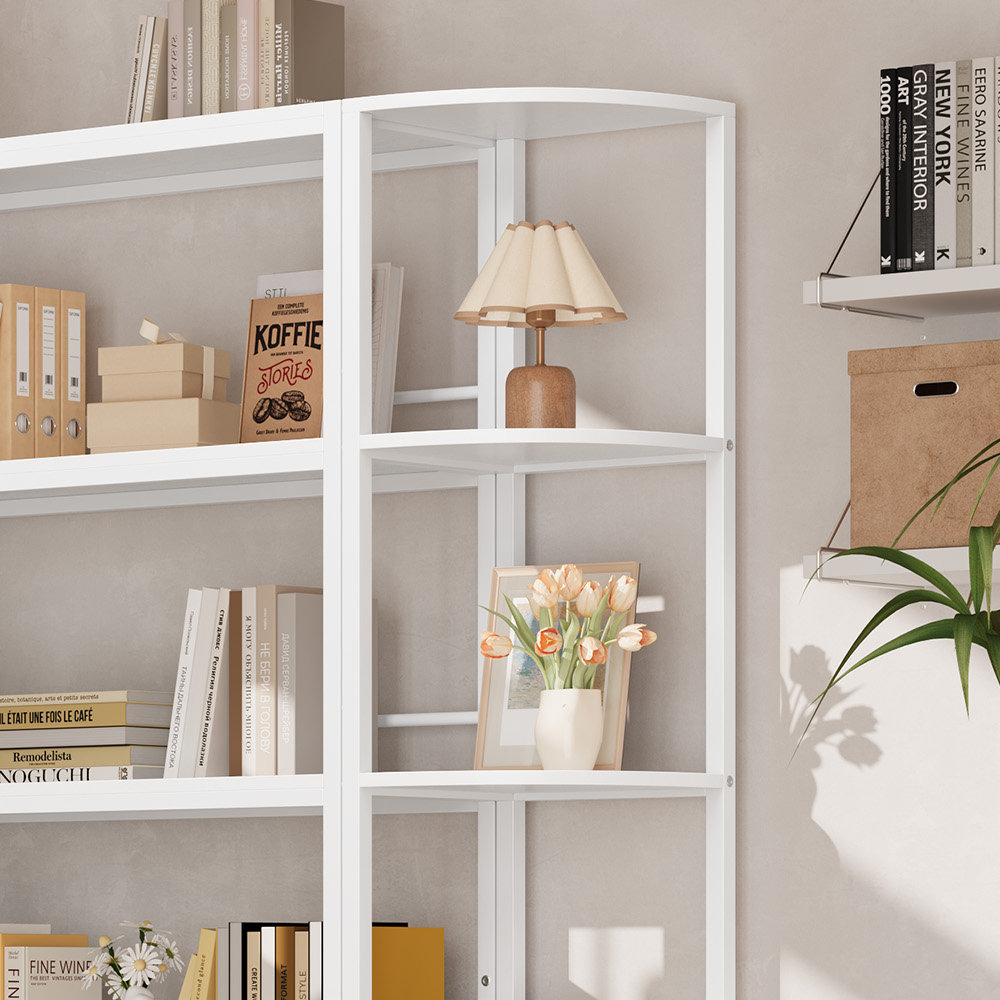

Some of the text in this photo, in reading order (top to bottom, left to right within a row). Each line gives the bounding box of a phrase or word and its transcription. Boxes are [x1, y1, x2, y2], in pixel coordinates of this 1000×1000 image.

[880, 75, 891, 115] 1000
[898, 76, 909, 105] ART
[935, 69, 951, 186] NEW YORK
[975, 68, 986, 171] EERO SAARINE
[913, 70, 928, 211] GRAY INTERIOR
[957, 84, 970, 203] FINE WINES
[253, 320, 323, 355] KOFFIE
[257, 358, 313, 394] STORIES
[209, 656, 219, 690] Религия
[260, 642, 271, 753] НЕ БЕРИ В ГОЛОВУ
[0, 707, 93, 725] IL ÉTAIT UNE FOIS LE CAFÉ
[13, 751, 72, 763] Remodelista
[198, 722, 209, 767] водолазки
[0, 768, 91, 784] NOGUCHI
[30, 960, 92, 974] FINE WINE
[198, 954, 206, 977] glance
[299, 971, 307, 1000] STYLE
